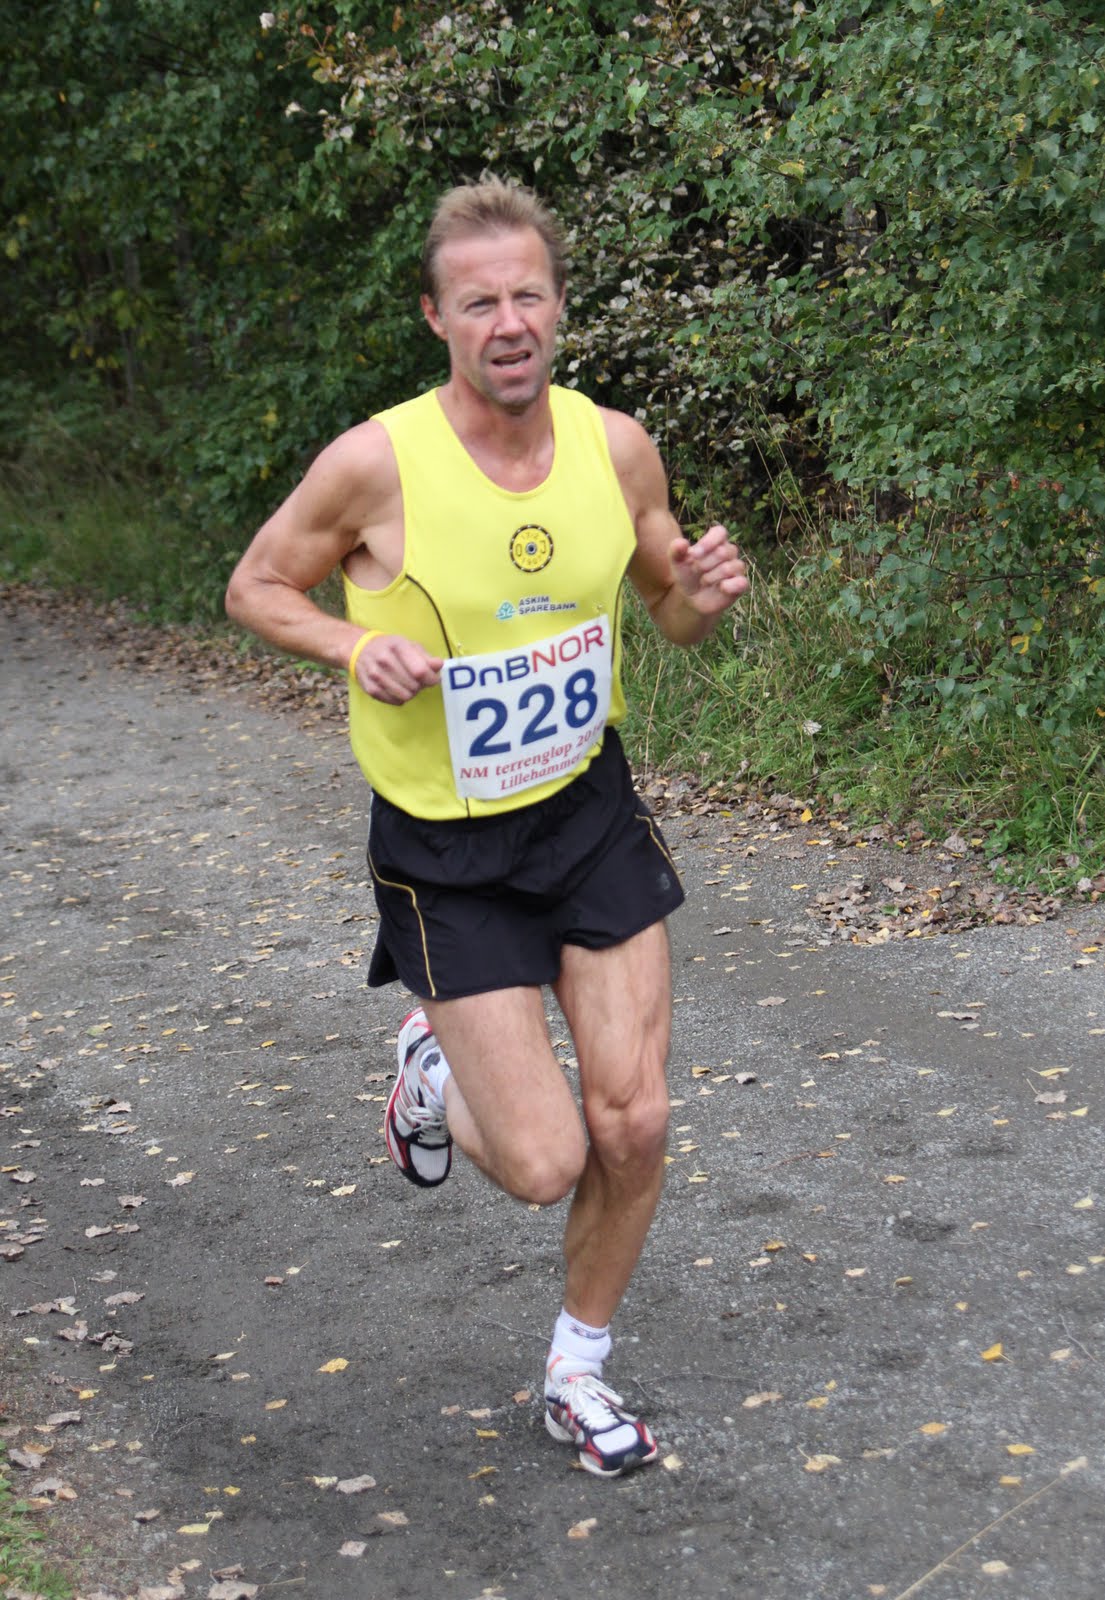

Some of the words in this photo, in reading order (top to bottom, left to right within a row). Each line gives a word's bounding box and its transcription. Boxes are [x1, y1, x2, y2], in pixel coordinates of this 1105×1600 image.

[518, 595, 550, 606] ASKIM
[519, 602, 577, 615] SPAREBANK
[465, 668, 598, 757] 228
[459, 766, 489, 779] NM
[495, 742, 573, 776] terrengløp
[500, 751, 583, 791] Lillehammer
